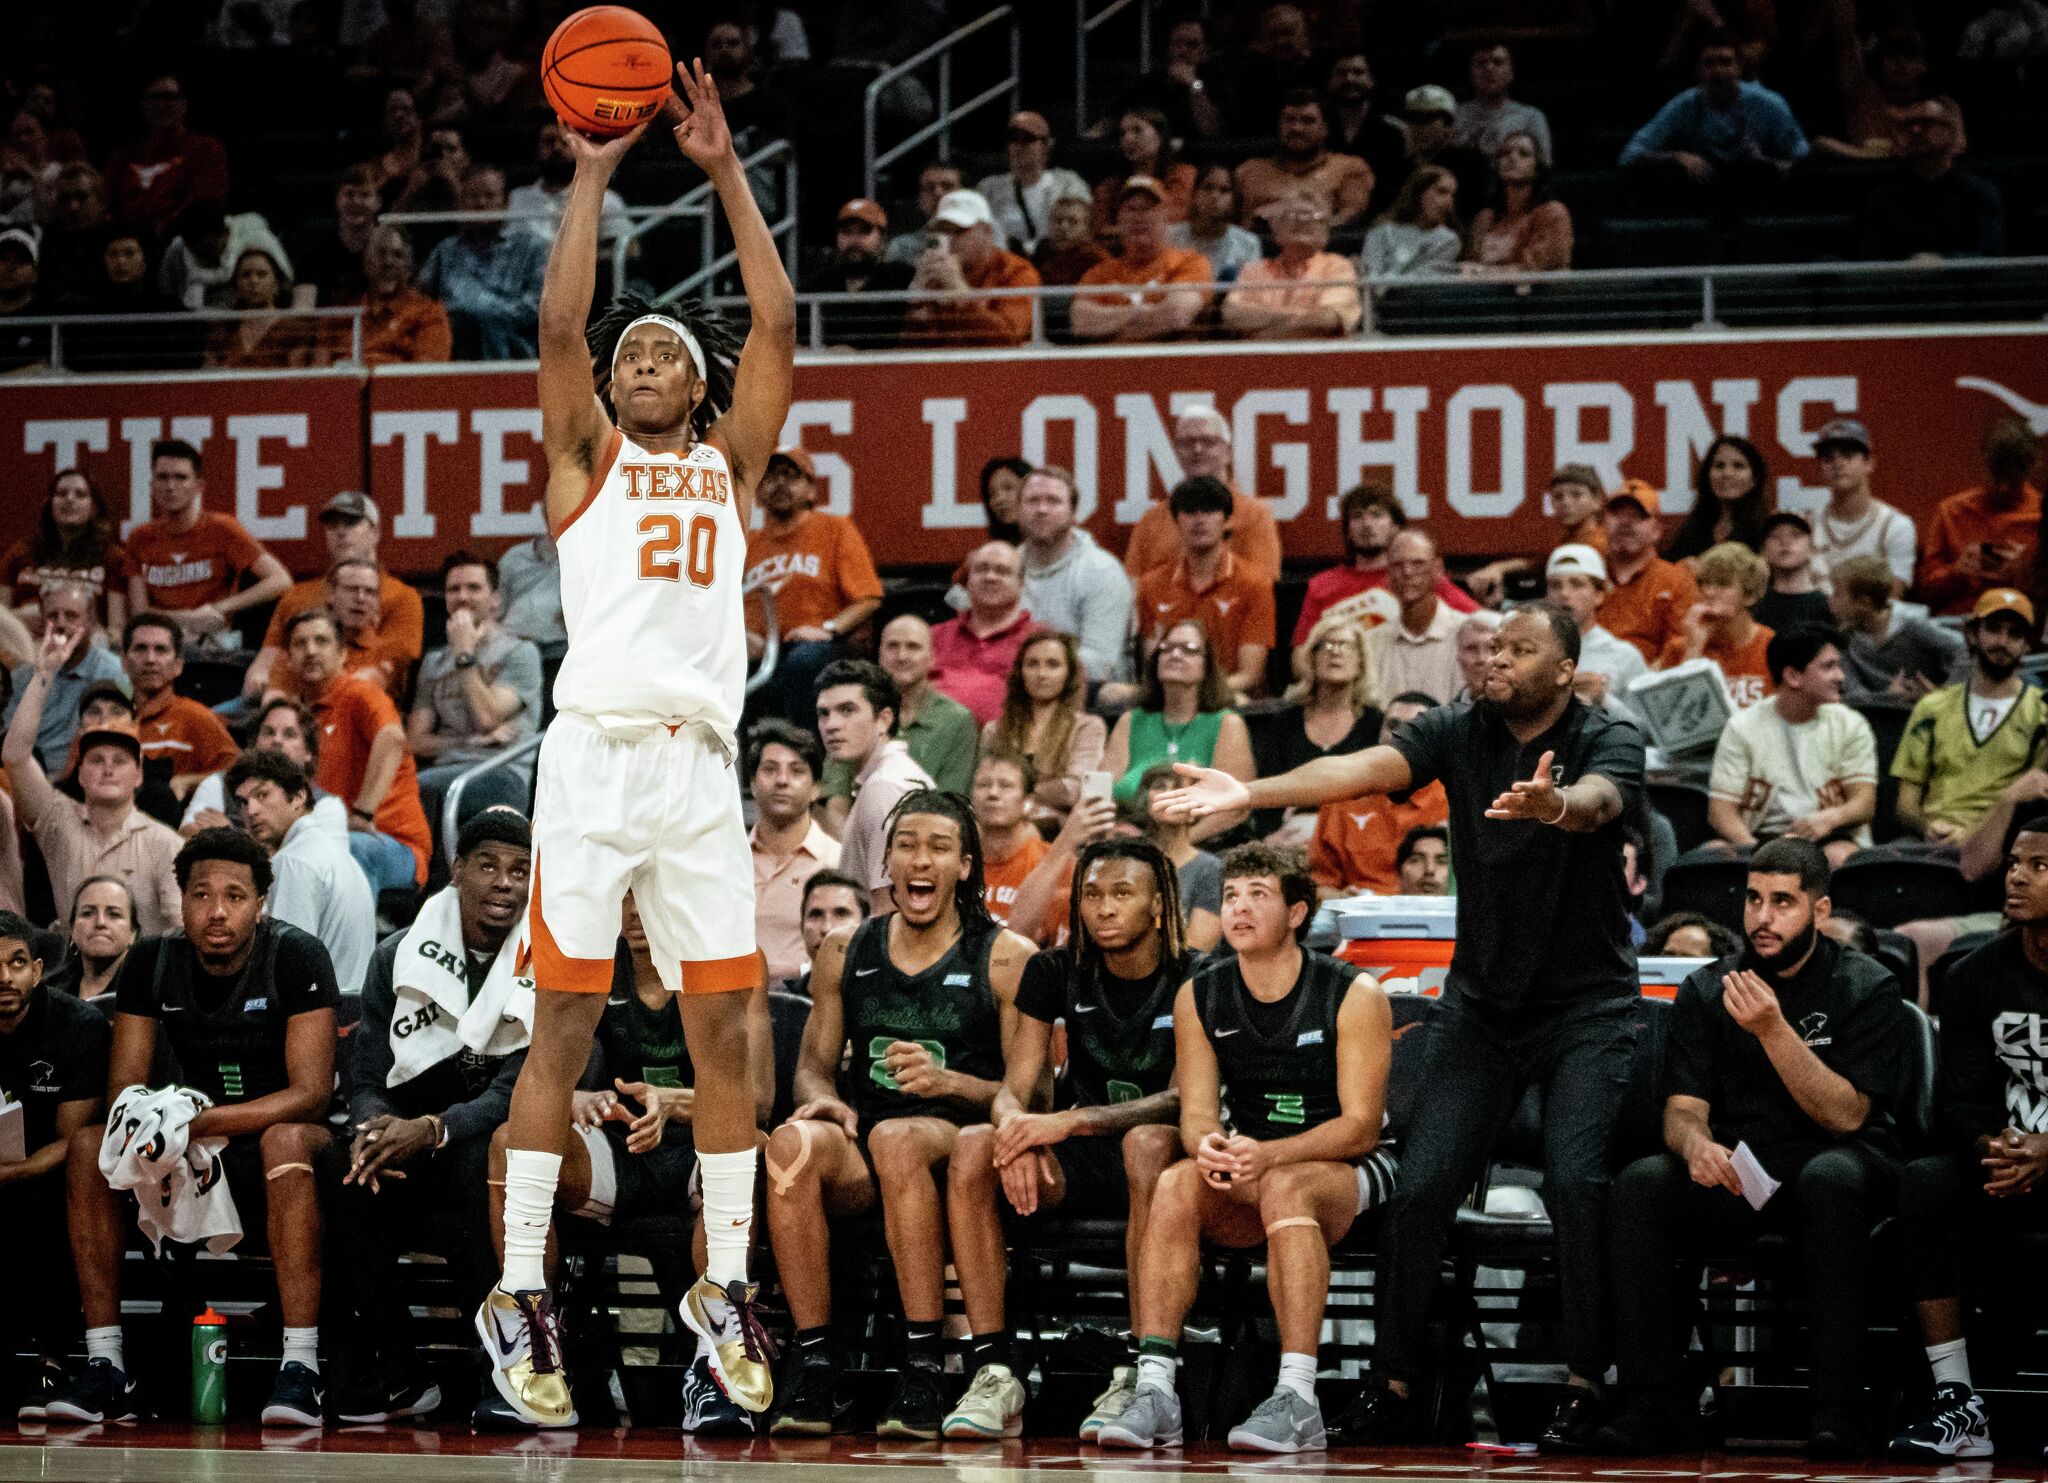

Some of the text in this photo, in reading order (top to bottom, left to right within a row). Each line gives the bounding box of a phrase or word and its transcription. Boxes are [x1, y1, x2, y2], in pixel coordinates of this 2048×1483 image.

[371, 400, 853, 537] TES
[922, 376, 1858, 528] LONGHORNS
[620, 463, 728, 506] TEXAS
[636, 512, 718, 589] 20
